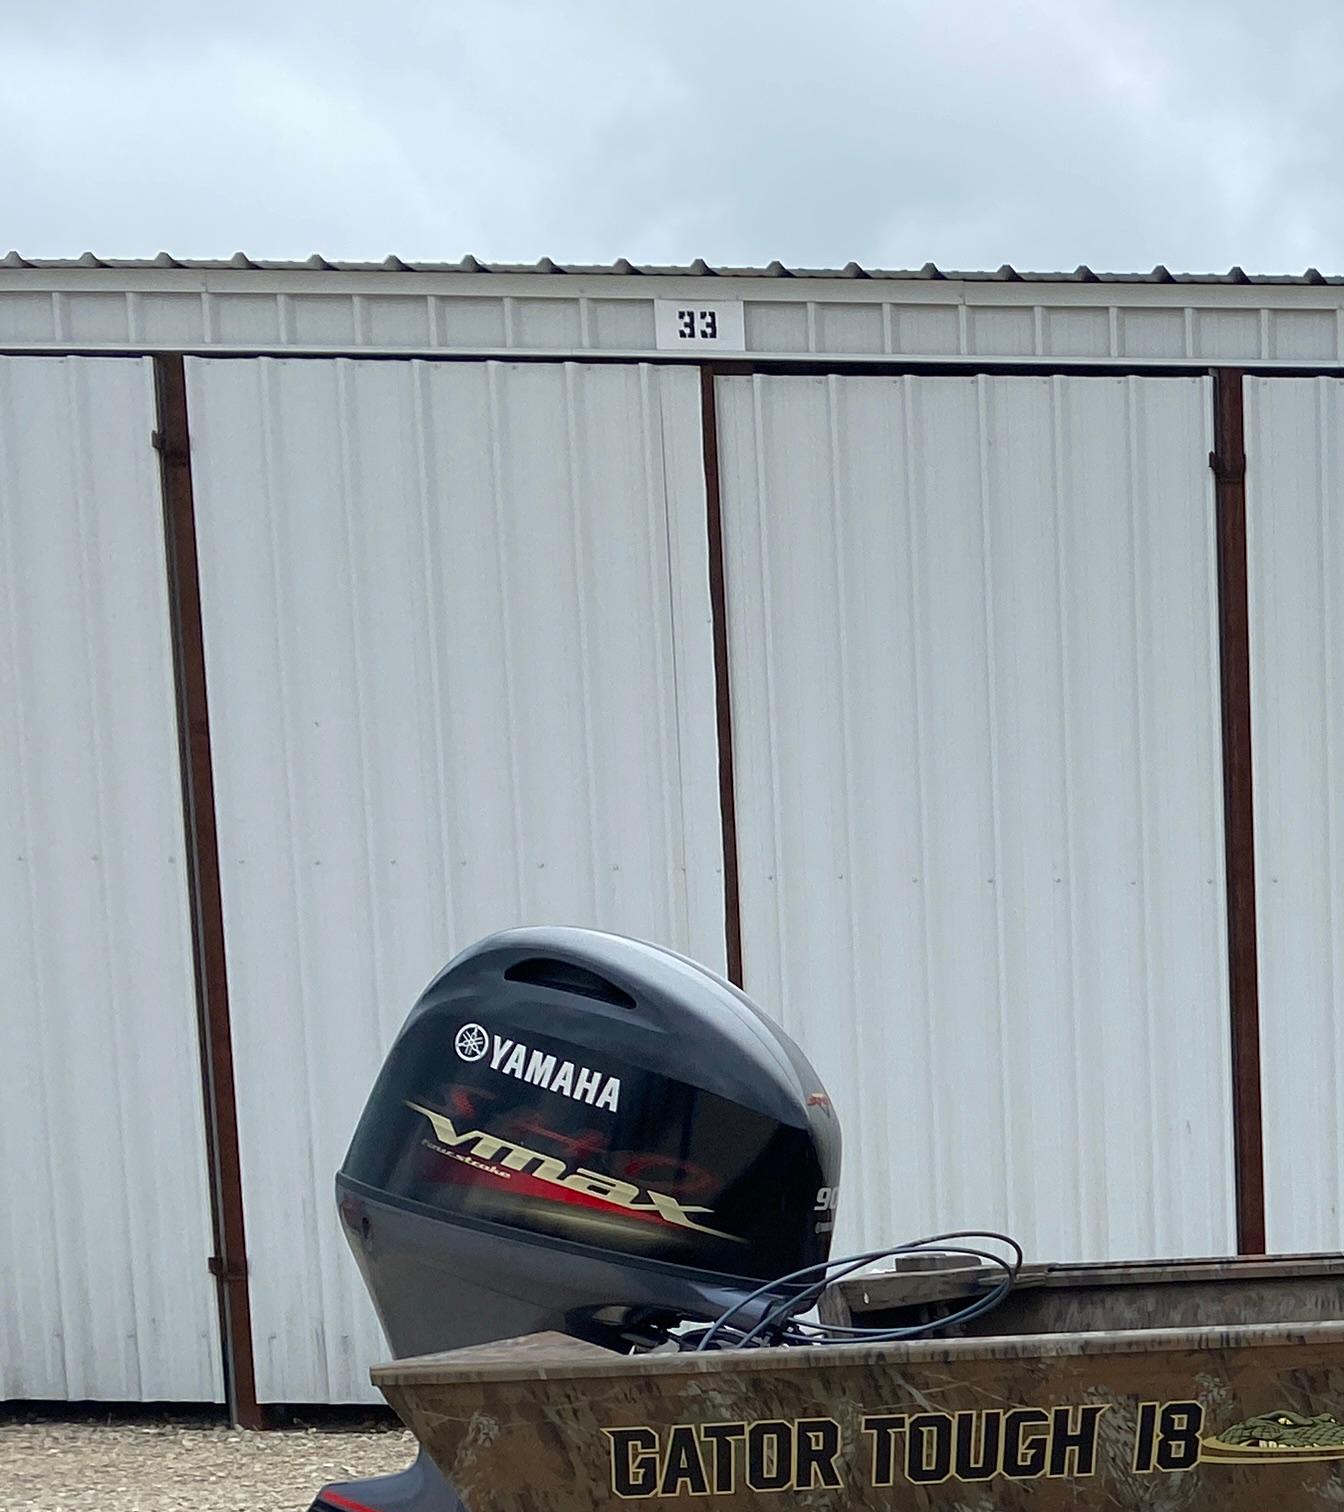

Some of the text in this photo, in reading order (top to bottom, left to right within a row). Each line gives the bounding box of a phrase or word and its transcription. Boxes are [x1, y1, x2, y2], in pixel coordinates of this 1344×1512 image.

[678, 310, 718, 339] 33
[489, 1034, 622, 1113] YAMAHA
[600, 1400, 1203, 1499] GATOR TOUGH 18
